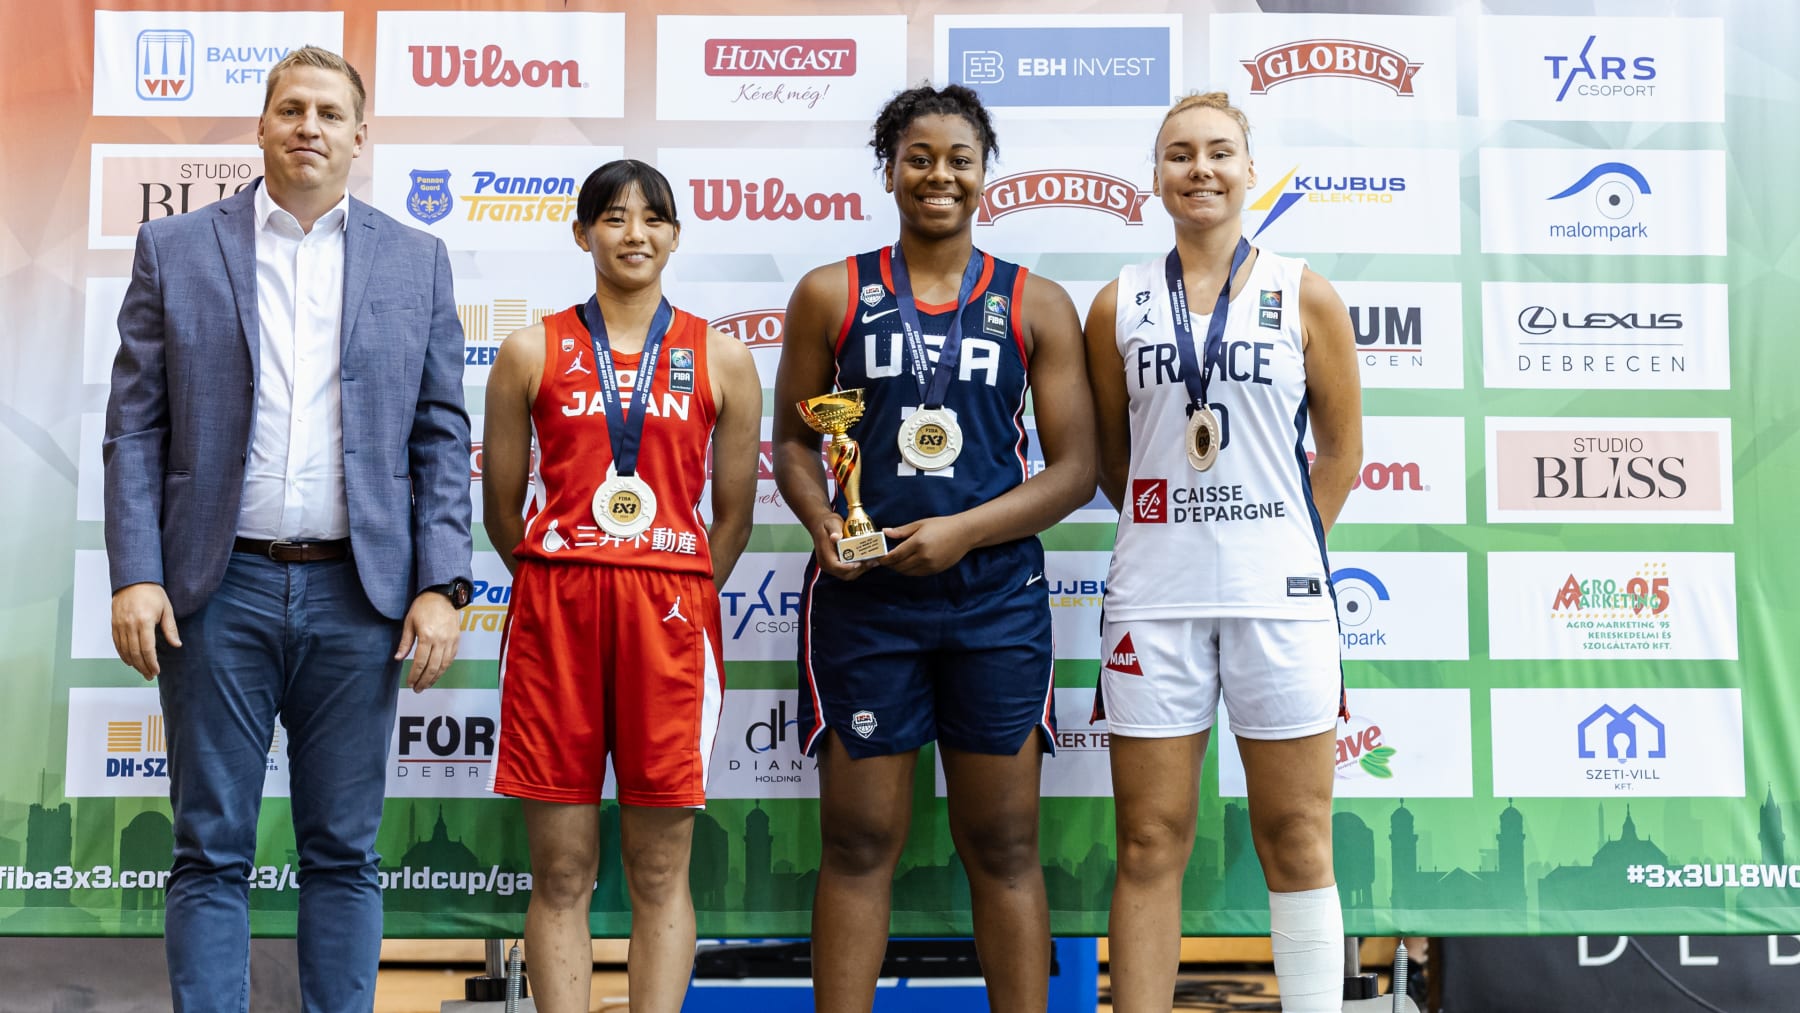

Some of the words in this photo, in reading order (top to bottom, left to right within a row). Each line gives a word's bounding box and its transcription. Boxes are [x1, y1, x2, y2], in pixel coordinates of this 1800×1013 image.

[408, 45, 582, 88] Wilson
[1018, 58, 1067, 76] EBH
[1074, 57, 1156, 76] INVEST
[1264, 46, 1399, 81] GLOBUS
[144, 79, 185, 96] VIV
[1578, 84, 1656, 96] CSOPORT
[180, 163, 252, 179] STUDIO
[472, 171, 575, 195] Pannon
[1295, 176, 1406, 191] KUJBUS
[689, 178, 865, 221] Wilson
[991, 176, 1128, 210] GLOBUS
[1308, 192, 1393, 203] ELEKTRO
[460, 195, 577, 222] Transfer
[1550, 221, 1648, 241] malompark
[1349, 306, 1422, 346] UM
[1563, 313, 1683, 329] LEXUS
[1138, 341, 1274, 388] FRNCE
[1365, 354, 1424, 367] CEN
[1518, 355, 1685, 372] DEBRECEN
[673, 372, 691, 381] FIBA
[562, 391, 690, 421] JAAN
[1573, 438, 1644, 453] STUDIO
[1532, 456, 1688, 499] BLISS
[1173, 485, 1244, 504] CAISSE
[1174, 501, 1285, 523] D'EPARGNE
[1567, 621, 1594, 629] AGRO
[1596, 621, 1655, 629] MARKETING
[1110, 653, 1137, 666] MAIF
[397, 766, 479, 778] DEBR
[729, 760, 820, 771] DIAN
[755, 775, 802, 783] HOLDING
[1586, 769, 1661, 780] SZETI-VILL
